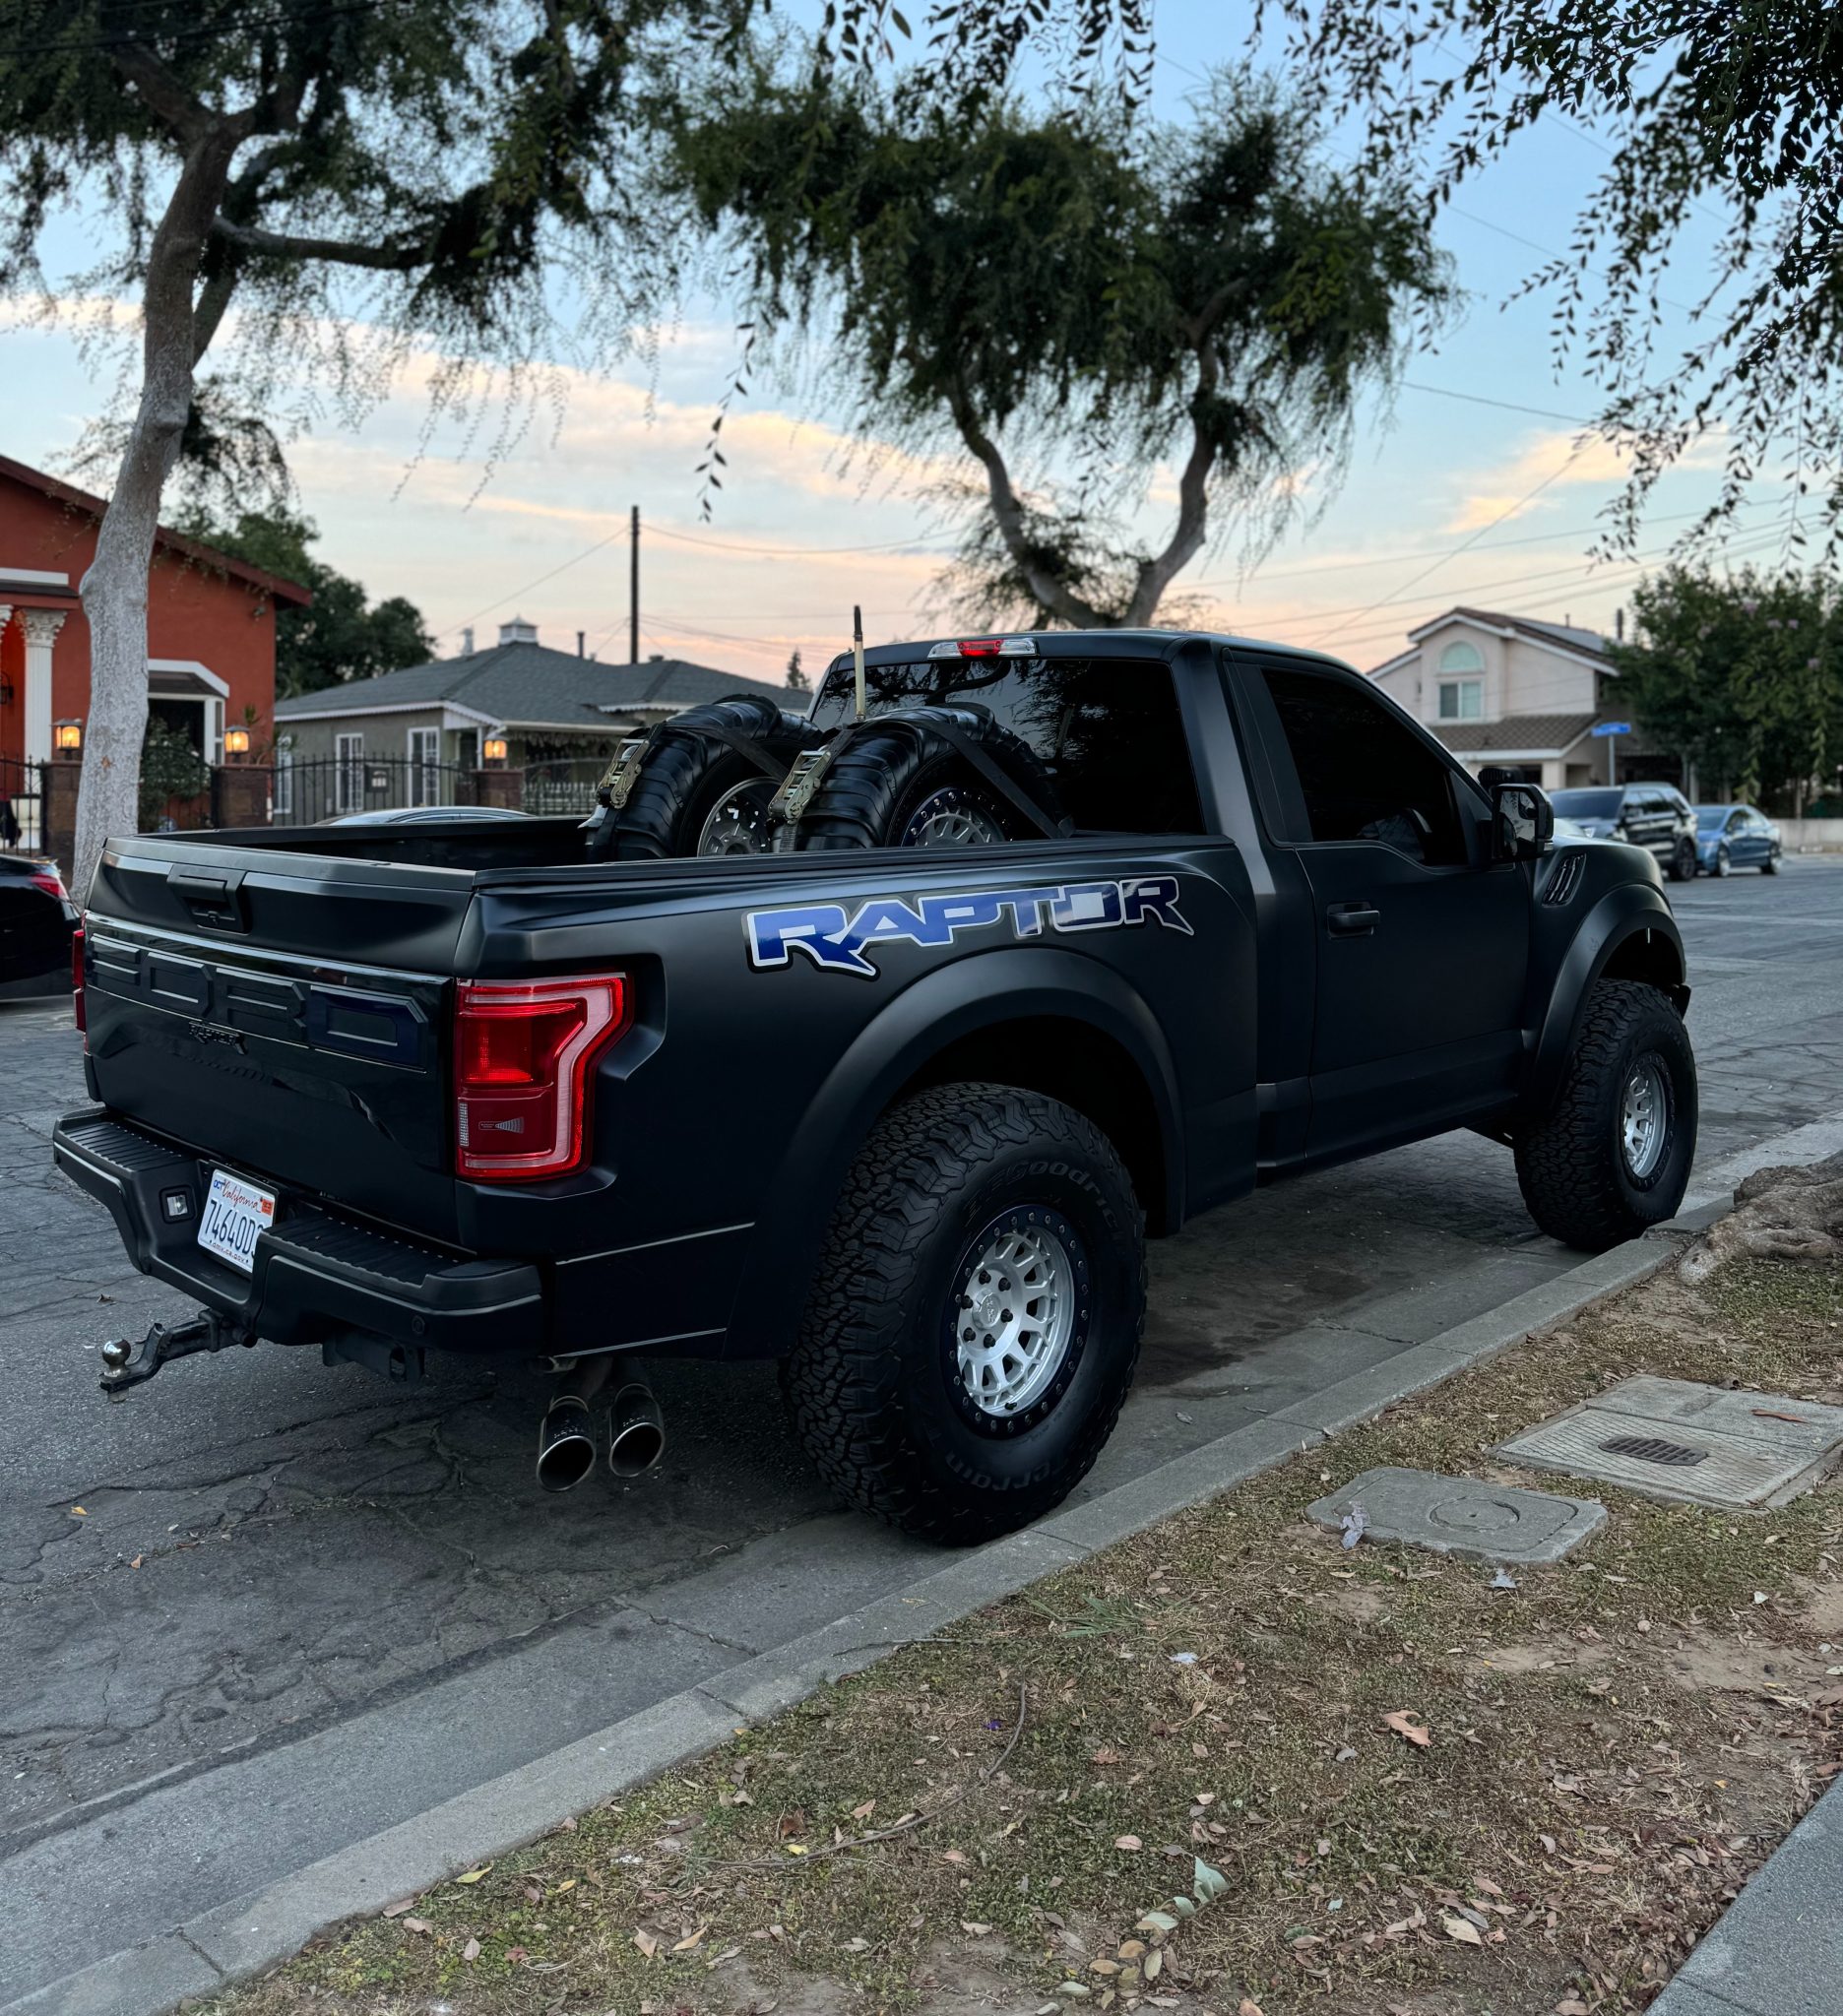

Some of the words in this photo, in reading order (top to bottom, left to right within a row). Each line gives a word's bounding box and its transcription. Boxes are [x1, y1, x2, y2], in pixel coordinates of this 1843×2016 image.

[748, 875, 1195, 978] RAPTOR
[86, 933, 428, 1070] FORD
[222, 1179, 262, 1214] California
